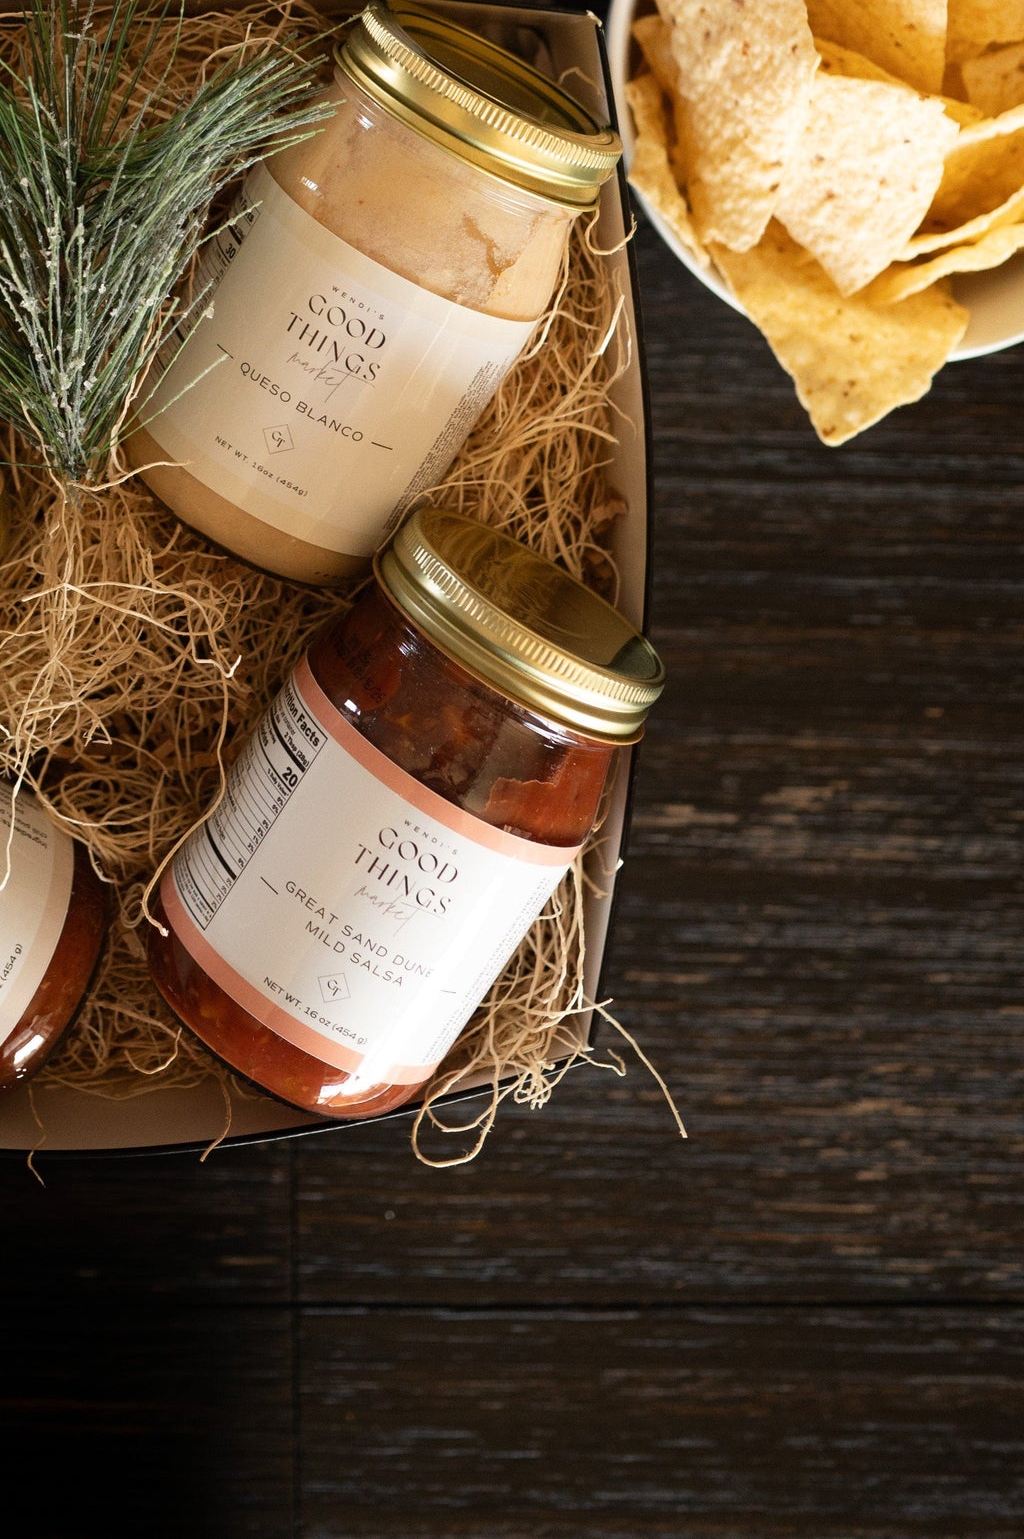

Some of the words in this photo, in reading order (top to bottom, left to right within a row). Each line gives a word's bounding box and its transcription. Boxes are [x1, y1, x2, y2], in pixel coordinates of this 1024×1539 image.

[308, 294, 386, 349] GOOD
[332, 286, 385, 320] WENDI'S
[287, 312, 381, 381] THINGS
[240, 362, 291, 403] QUESO
[295, 401, 364, 442] BLANCO
[286, 352, 375, 403] market
[214, 436, 233, 451] NET
[234, 450, 249, 464] WT.
[252, 462, 274, 479] 16oz
[276, 476, 309, 497] (454g)
[297, 714, 320, 747] Facts
[282, 767, 298, 788] 20
[378, 827, 458, 883] GOOD
[404, 819, 457, 855] WENDI'S
[355, 844, 451, 914] THINGS
[285, 880, 339, 925] GREAT
[341, 925, 388, 958] SAND
[354, 885, 445, 937] market
[0, 955, 17, 981] (454
[14, 943, 24, 955] g)
[305, 920, 346, 954] MILD
[350, 952, 403, 988] SALSA
[263, 976, 284, 995] NET
[285, 992, 302, 1010] WT.
[304, 1006, 317, 1020] 16
[319, 1016, 331, 1027] oz
[332, 1023, 357, 1041] (454
[357, 1037, 368, 1046] g)
